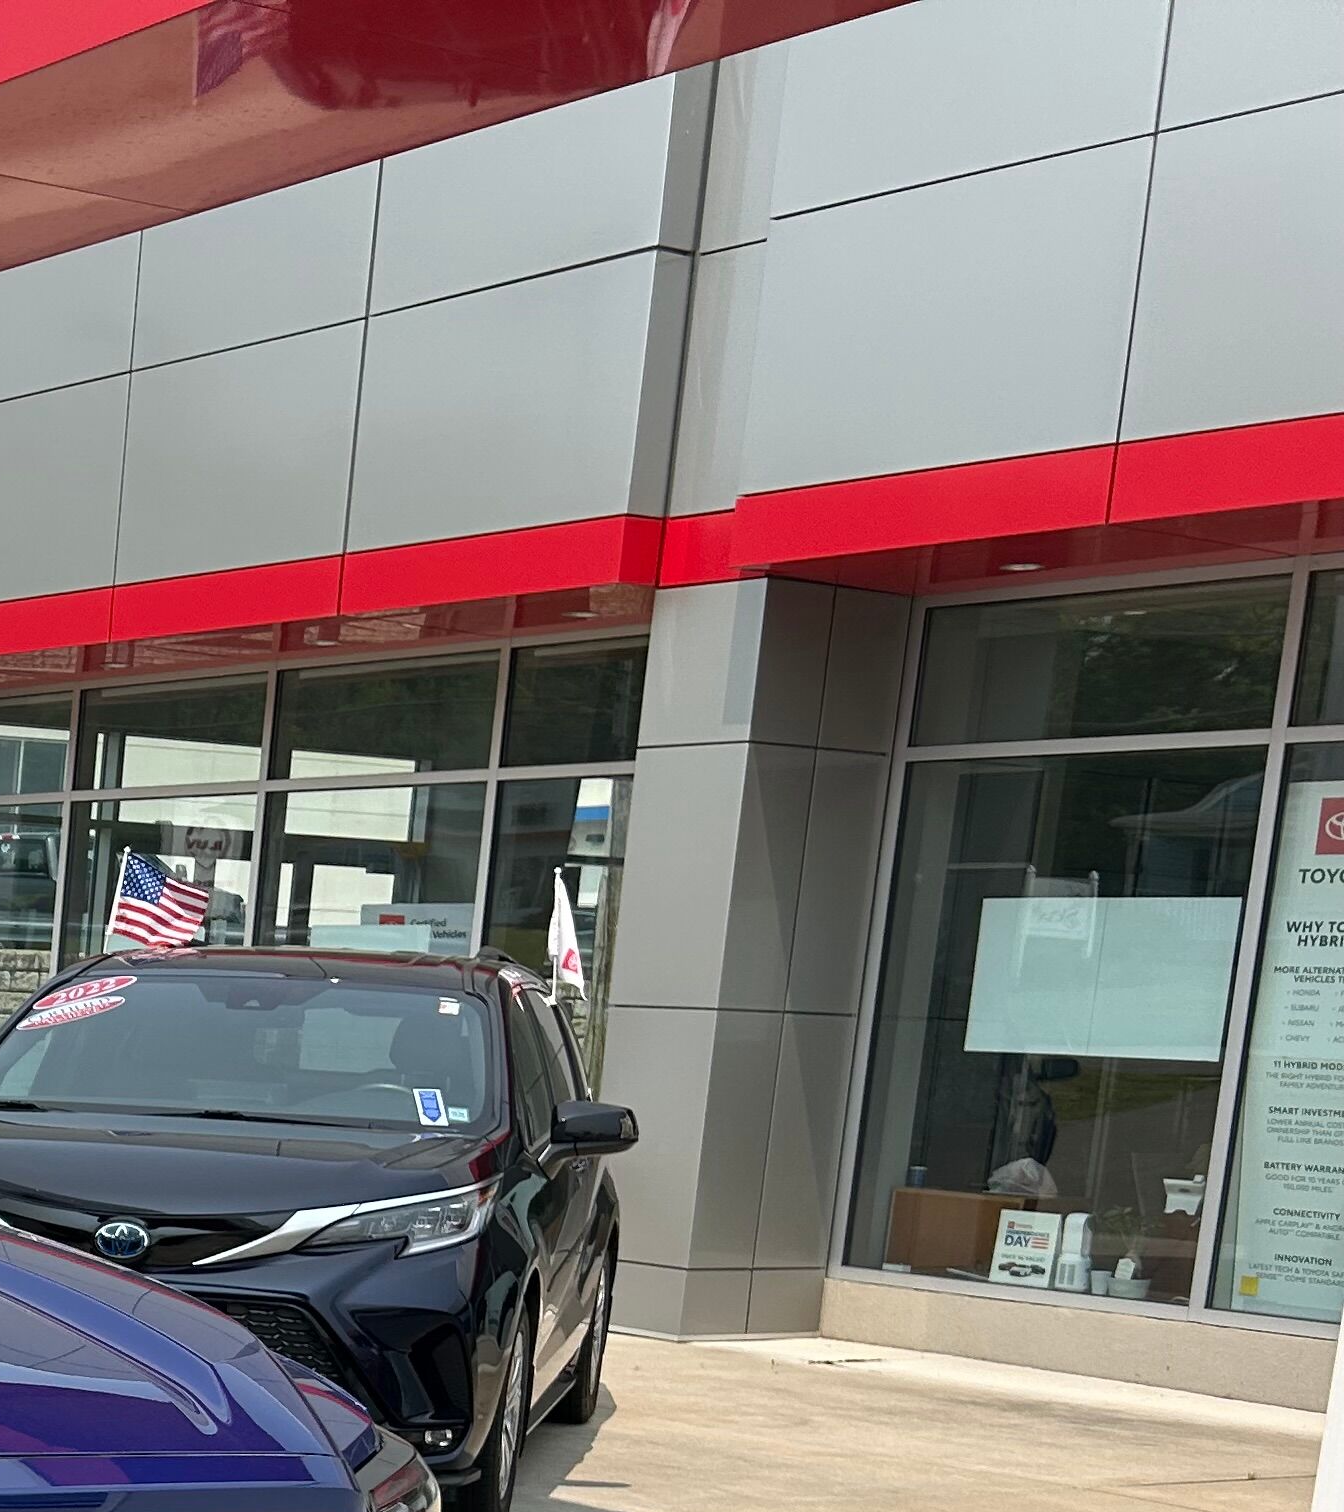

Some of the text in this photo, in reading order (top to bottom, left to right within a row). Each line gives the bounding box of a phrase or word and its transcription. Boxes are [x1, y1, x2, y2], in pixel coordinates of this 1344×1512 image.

[1298, 868, 1344, 884] TOY
[1286, 921, 1324, 933] WHY
[1273, 966, 1300, 974] MORE
[1293, 975, 1335, 984] VEHICLES
[52, 978, 117, 1005] 2022
[1283, 1061, 1318, 1070] HYBRID
[1268, 1106, 1299, 1115] SMART
[1263, 1161, 1301, 1171] BATTERY
[1264, 1173, 1289, 1181] GOOD
[1317, 1177, 1340, 1185] YEARS
[1273, 1208, 1340, 1220] CONNECTIVITY
[1004, 1234, 1031, 1247] DAY
[1274, 1253, 1332, 1266] INNOVATION
[1248, 1263, 1272, 1271] LATEST
[1274, 1265, 1293, 1273] TECH
[1302, 1268, 1329, 1277] TOYOTA
